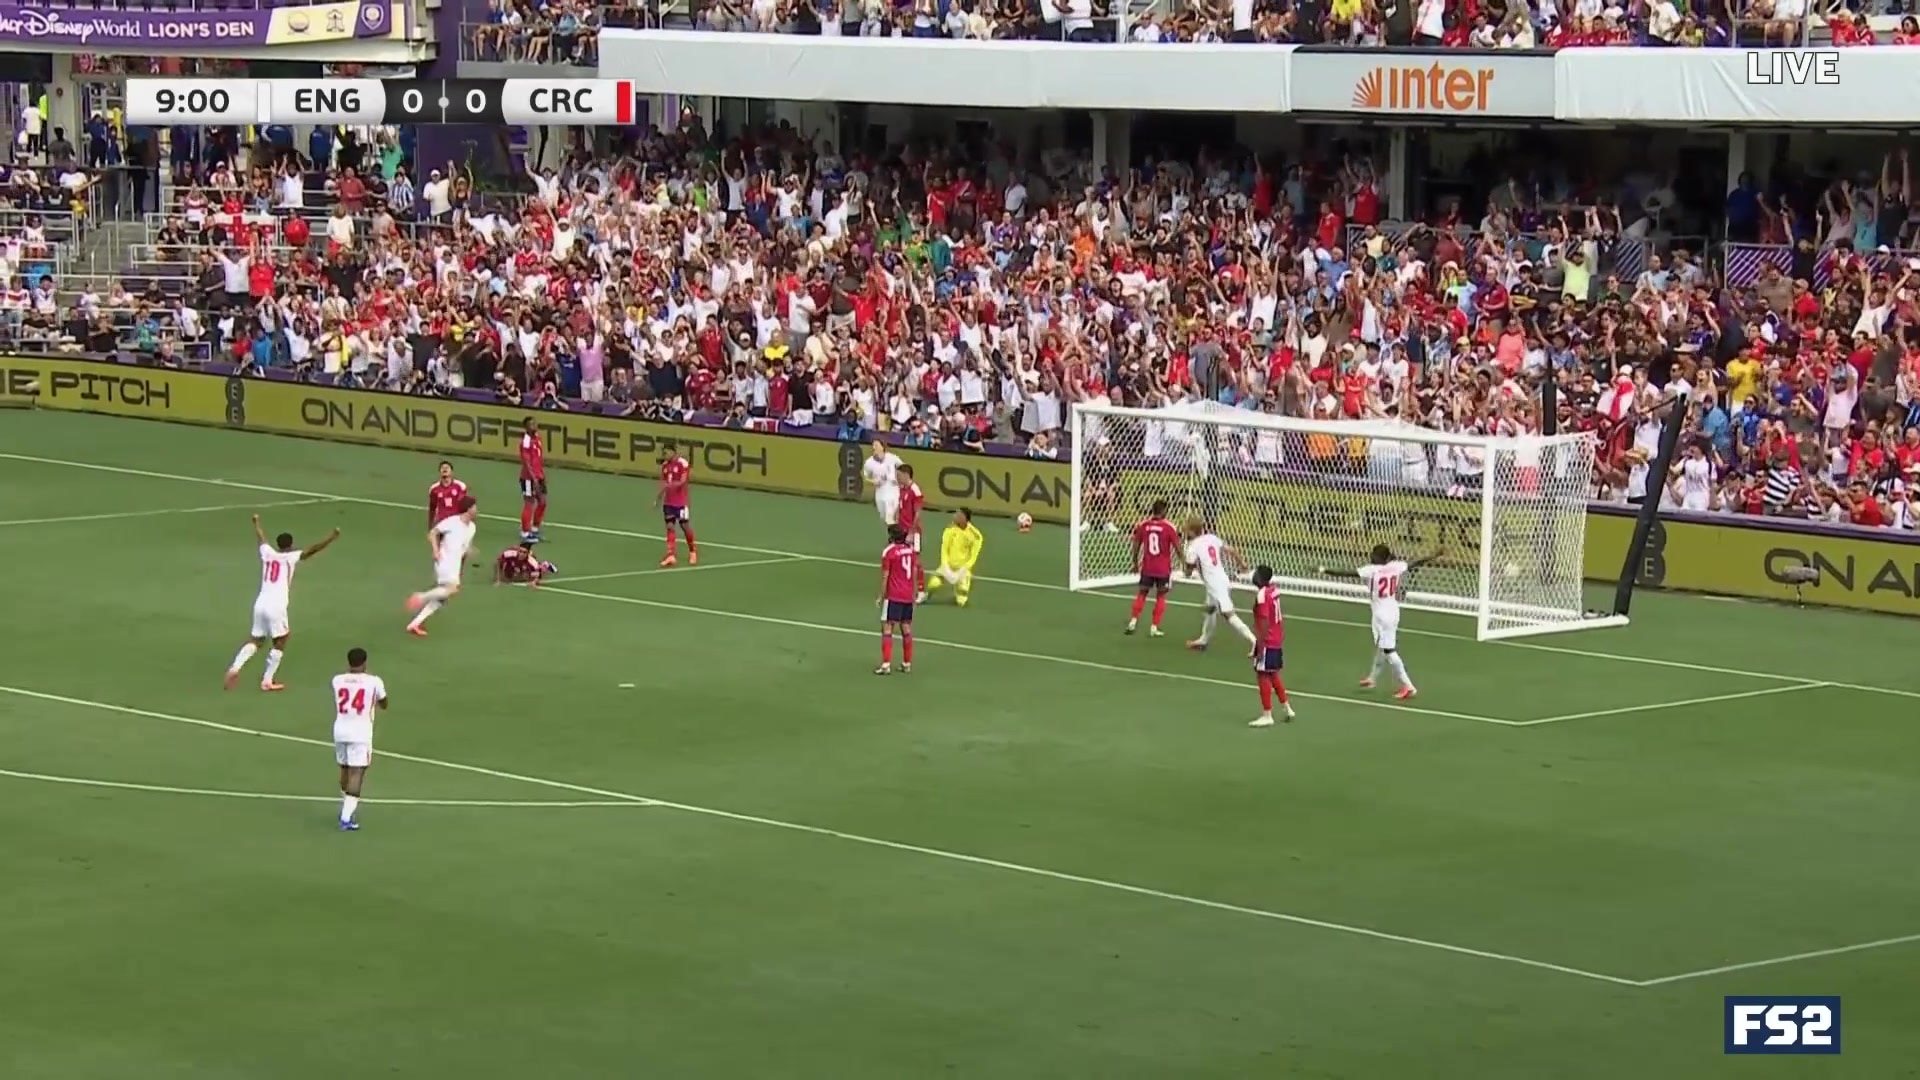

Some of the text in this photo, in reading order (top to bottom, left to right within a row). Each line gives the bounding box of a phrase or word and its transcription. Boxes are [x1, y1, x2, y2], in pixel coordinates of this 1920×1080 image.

[93, 19, 141, 38] World
[148, 23, 209, 38] LION'S
[215, 22, 254, 37] DEN
[0, 368, 170, 409] E PITCH
[301, 398, 353, 430] ON
[361, 404, 438, 439] AND
[447, 414, 526, 447] OFF
[538, 422, 620, 461] THE
[938, 466, 1011, 503] ON
[1148, 532, 1161, 556] 8
[1208, 545, 1218, 567] 9
[901, 554, 913, 580] 4
[1764, 547, 1920, 599] ON A
[1378, 574, 1397, 599] 20
[337, 687, 366, 716] 24
